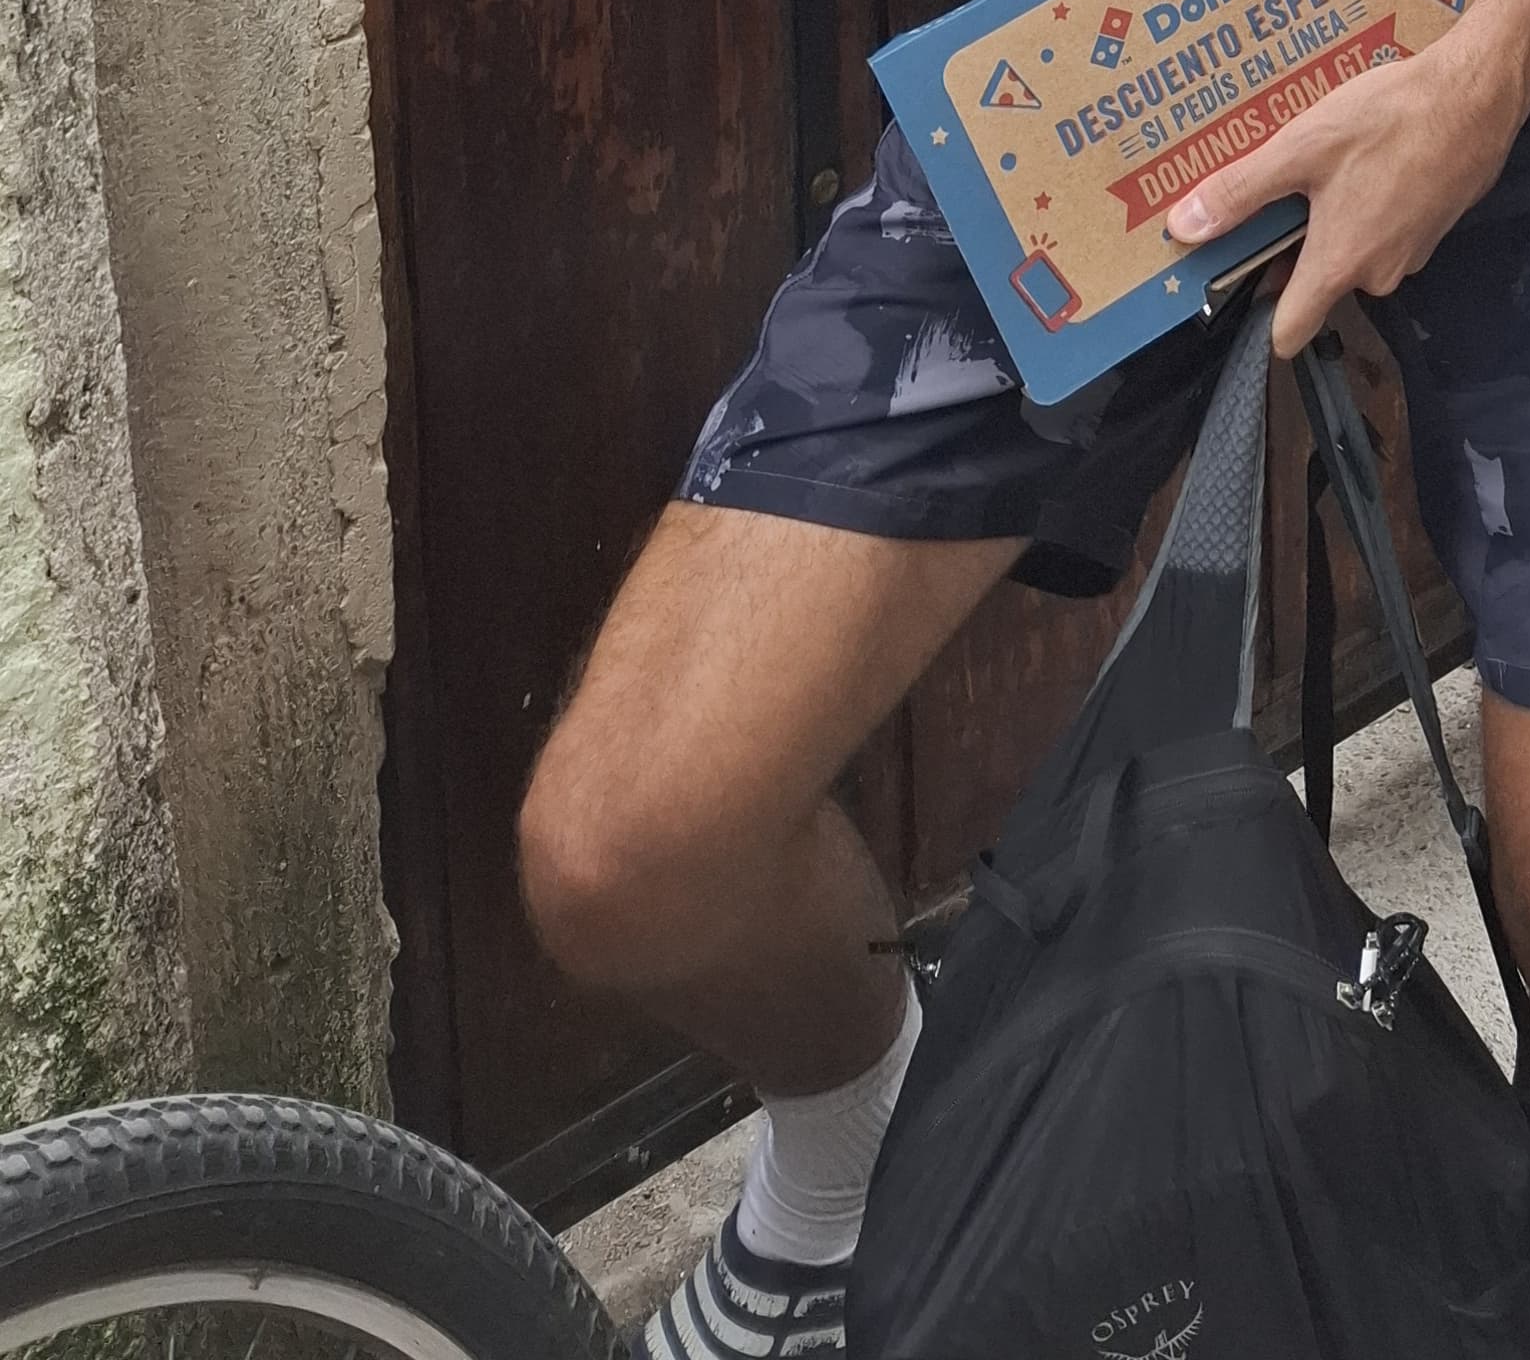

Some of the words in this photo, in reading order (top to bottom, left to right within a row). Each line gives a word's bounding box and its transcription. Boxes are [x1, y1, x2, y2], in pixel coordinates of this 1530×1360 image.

[1055, 23, 1242, 157] DESCUENTO
[1140, 115, 1169, 149] SI
[1169, 72, 1240, 132] PEDÍS
[1240, 49, 1277, 88] EN
[1277, 9, 1349, 66] LÍNEA
[1091, 1279, 1195, 1343] OSPREY
